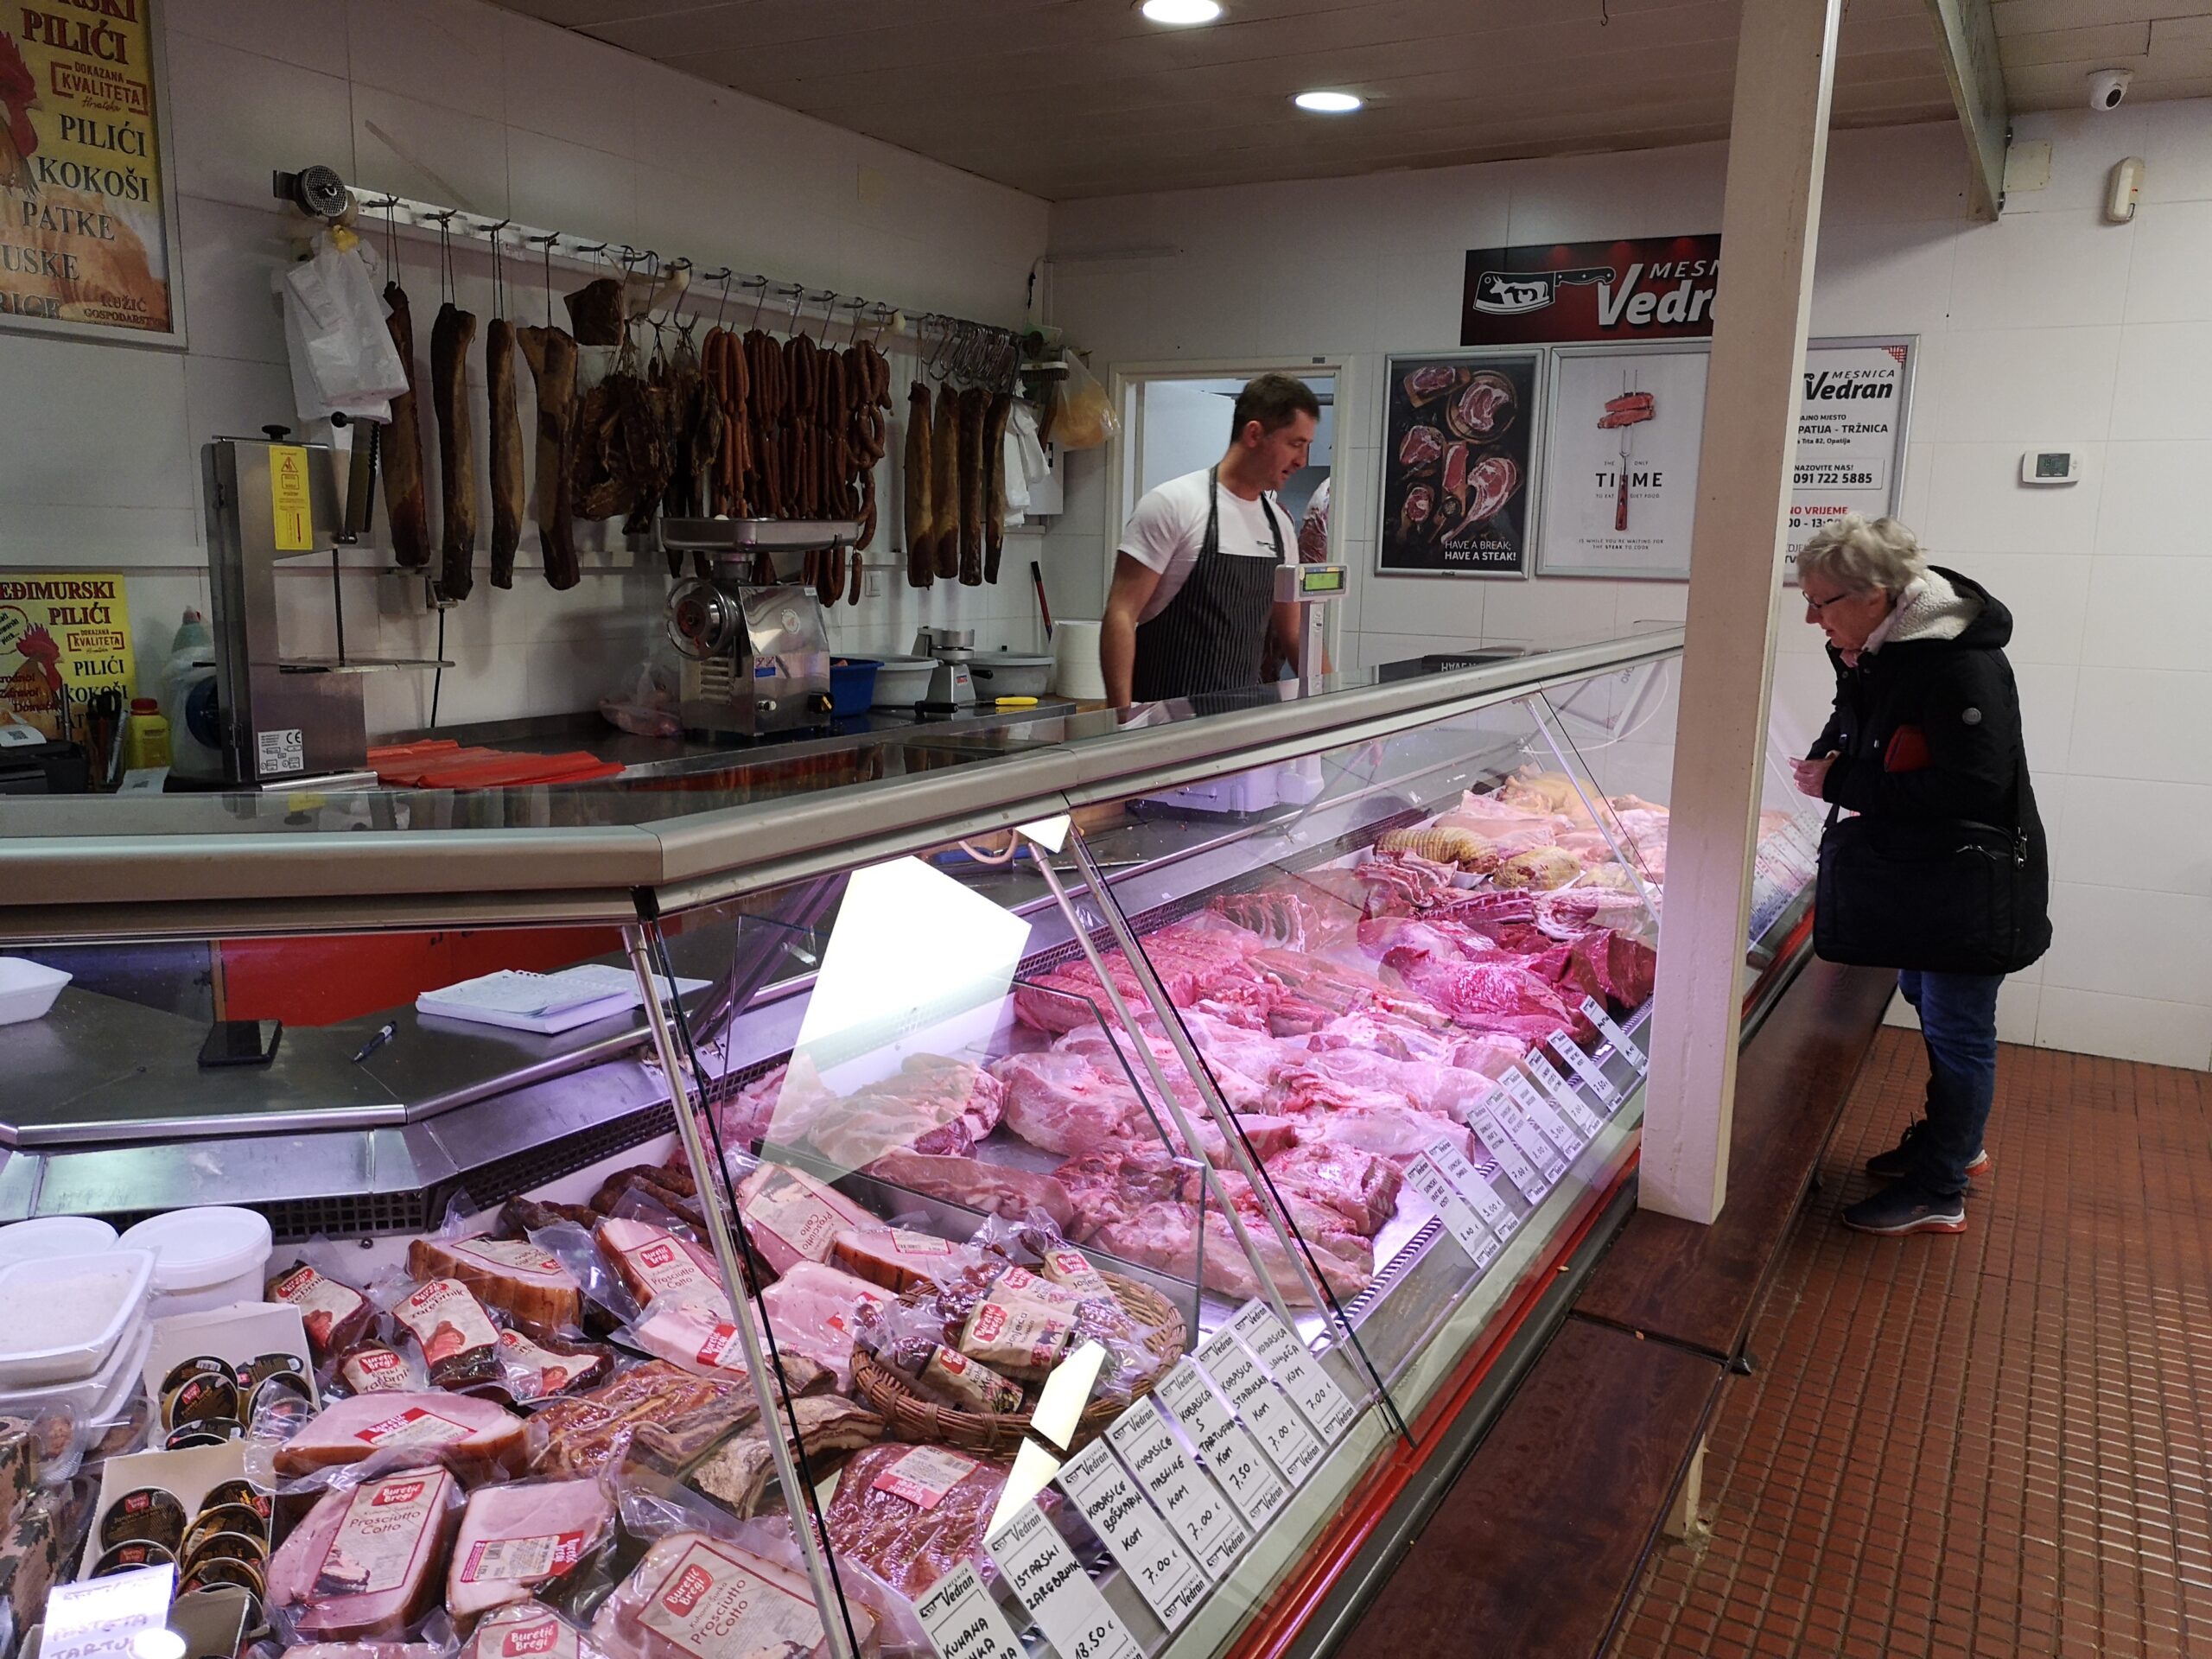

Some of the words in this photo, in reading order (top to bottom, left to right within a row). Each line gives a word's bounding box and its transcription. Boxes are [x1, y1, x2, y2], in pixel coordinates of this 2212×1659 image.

[21, 8, 129, 65] PILIĆI
[75, 61, 124, 83] DOKAZANA
[62, 73, 140, 105] KVALITETA
[59, 113, 147, 157] PILIĆI
[37, 156, 150, 202] KOKOŠI
[22, 200, 115, 241] PATKE
[1598, 263, 1717, 326] Vedr
[1806, 372, 1893, 400] Vedran
[1832, 370, 1895, 378] MESNICA
[1842, 423, 1888, 434] TRŽNICA
[1793, 474, 1814, 484] 091
[1817, 474, 1839, 483] 722
[1841, 474, 1872, 483] 5885
[1805, 506, 1848, 515] VRIJEME
[1445, 540, 1469, 550] HAVE
[1471, 540, 1478, 550] A
[1445, 551, 1471, 560] HAVE
[1472, 551, 1480, 561] A
[1482, 552, 1516, 561] STEAK!
[48, 601, 111, 626] PILIĆI
[73, 636, 121, 647] KVALITETA
[73, 655, 124, 677] PILIĆI
[651, 1267, 696, 1287] Prosciutto
[667, 1277, 693, 1289] Cotto
[1247, 1306, 1268, 1325] Vedran
[1211, 1336, 1234, 1357] Vedran
[1173, 1370, 1197, 1392] Vedran
[1220, 1360, 1254, 1395] KOBASICA
[1285, 1365, 1306, 1385] KOM
[1179, 1389, 1213, 1424] KOBASICA
[1252, 1402, 1270, 1422] KOM
[1306, 1388, 1326, 1411] 7.00
[1128, 1408, 1154, 1433] Vedran
[1335, 1406, 1355, 1428] Vedran
[1268, 1424, 1289, 1452] 7.00
[1080, 1451, 1109, 1477] Vedran
[1298, 1445, 1320, 1468] Vedran
[1229, 1462, 1251, 1491] 7.50
[383, 1484, 421, 1497] Buretić
[1166, 1484, 1190, 1510] KOM
[1261, 1485, 1285, 1511] Vedran
[349, 1510, 421, 1529] Prosciutto
[361, 1523, 402, 1535] Cotto
[1011, 1514, 1042, 1542] Vedran
[1186, 1510, 1213, 1541] 7.00
[1121, 1527, 1143, 1552] KOM
[1221, 1531, 1246, 1558] Vedran
[1014, 1543, 1060, 1591] ISTARSKI
[1141, 1556, 1171, 1586] 7.00
[666, 1567, 700, 1604] Buretić
[941, 1574, 976, 1607] Vedran
[1178, 1580, 1205, 1608] Vedran
[690, 1580, 746, 1645] Prosciutto
[715, 1599, 748, 1637] Cotto
[511, 1624, 554, 1641] Buretić
[515, 1637, 549, 1651] Bregi
[943, 1617, 988, 1659] KUHANA
